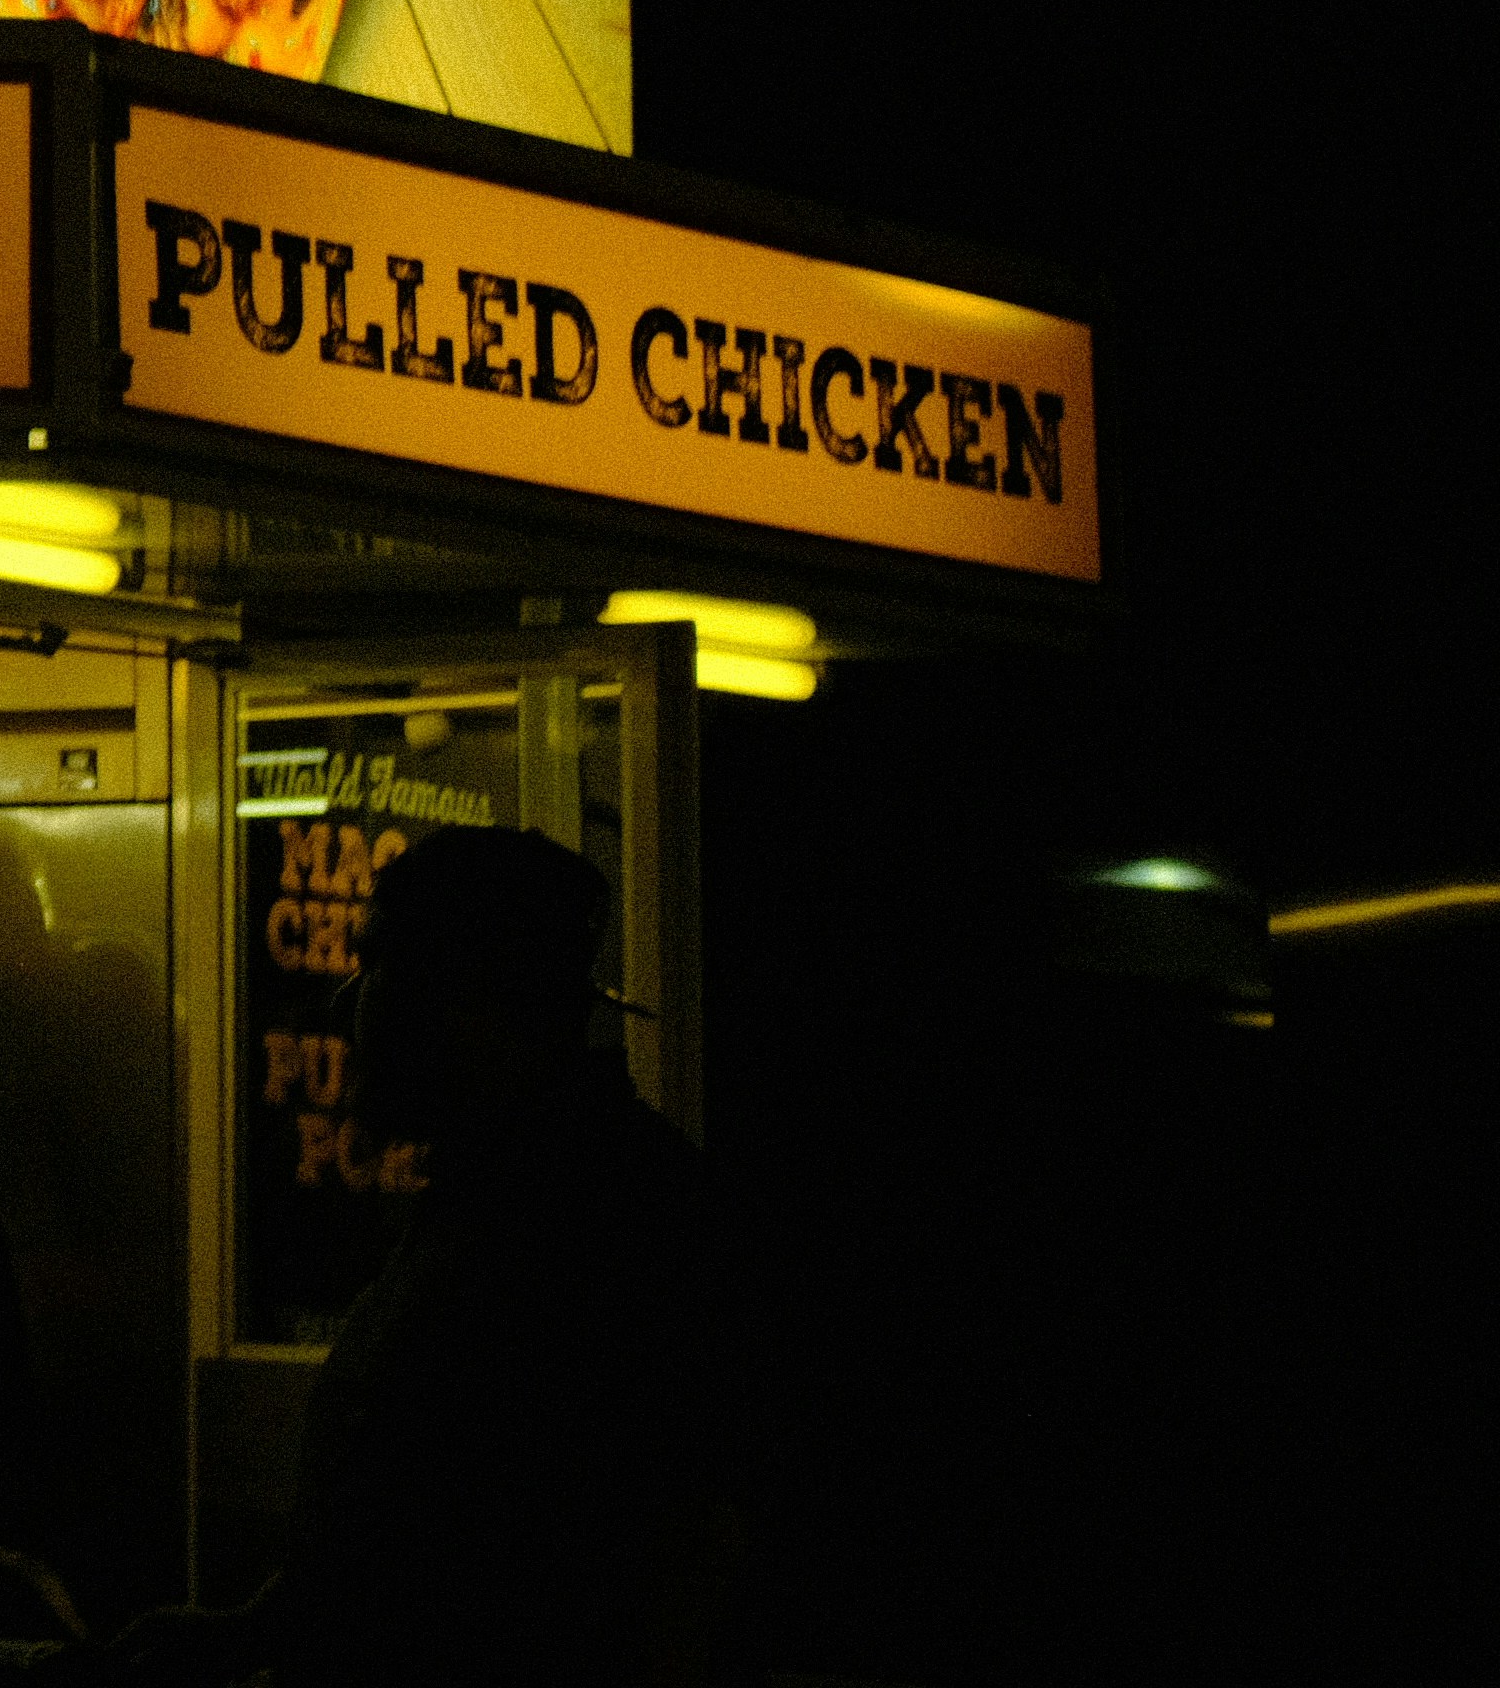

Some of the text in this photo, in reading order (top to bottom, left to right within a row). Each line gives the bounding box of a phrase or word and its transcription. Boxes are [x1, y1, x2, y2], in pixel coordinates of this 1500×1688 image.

[145, 197, 1065, 506] PULLED CHICKEN
[369, 753, 497, 827] Famous
